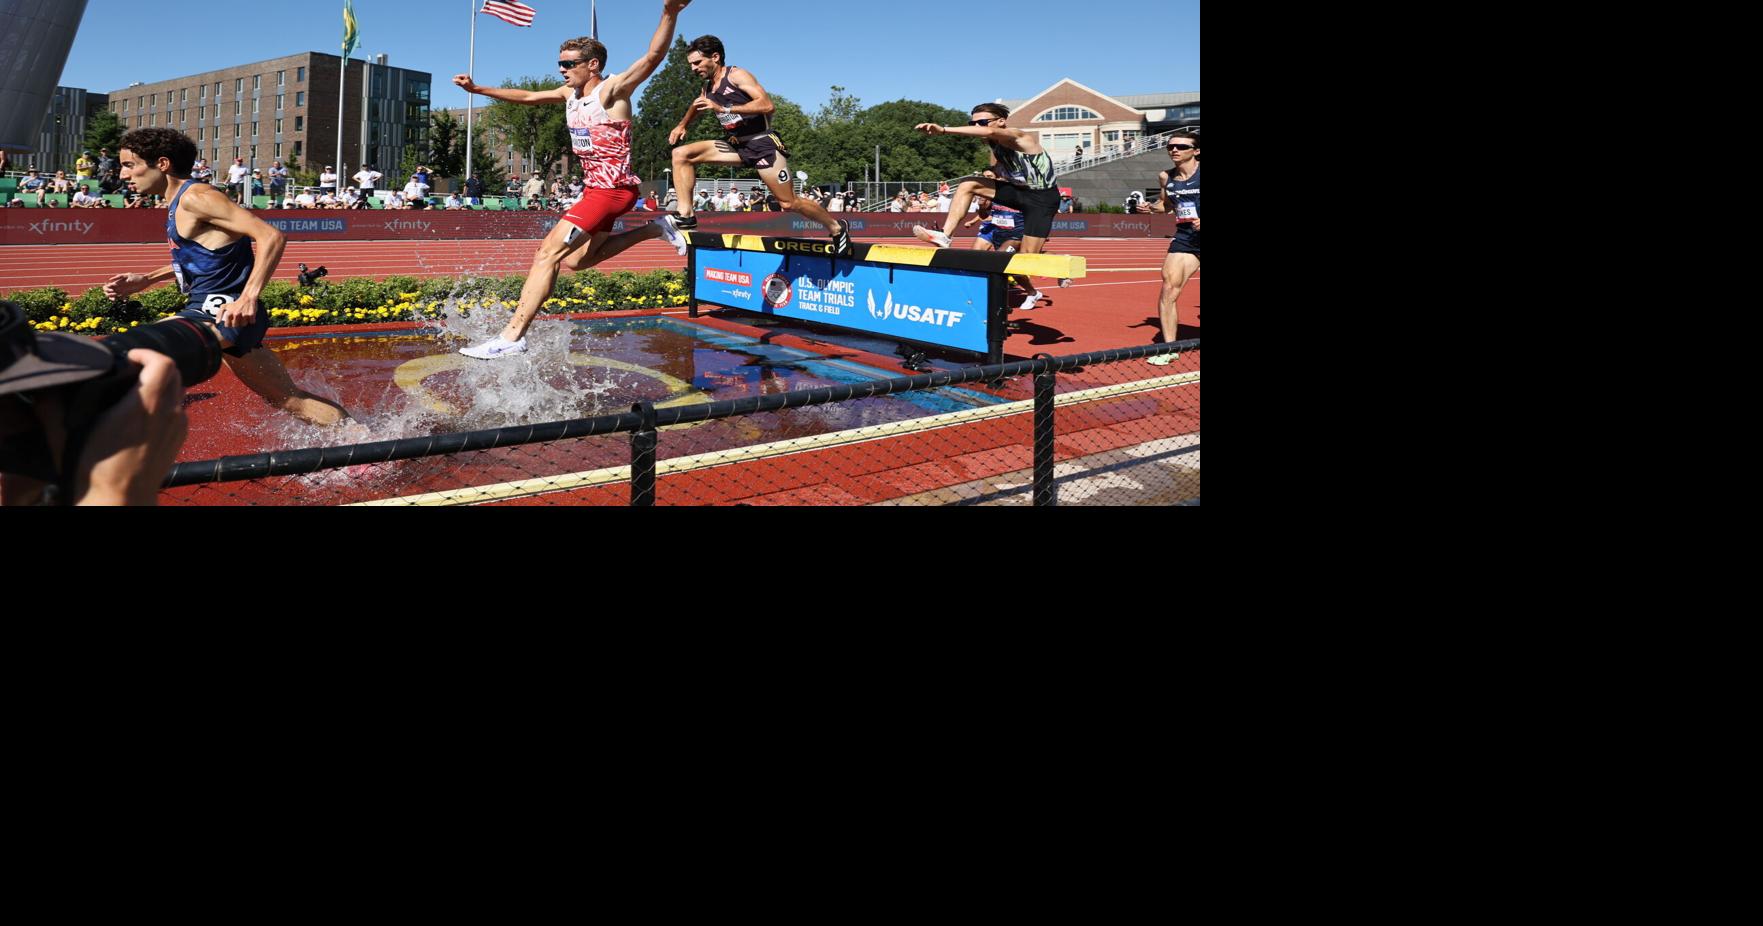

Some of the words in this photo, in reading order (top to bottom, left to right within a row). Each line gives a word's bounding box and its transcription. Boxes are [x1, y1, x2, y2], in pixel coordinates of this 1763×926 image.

[778, 169, 788, 182] 9
[28, 218, 94, 235] xfinity
[289, 220, 318, 231] TEAM
[320, 220, 343, 231] USA
[383, 218, 431, 232] xfinity
[1070, 221, 1085, 230] USA
[1112, 220, 1150, 232] xfinity
[774, 240, 852, 256] OREGO
[725, 272, 738, 283] TEAM
[738, 275, 750, 285] USA
[798, 277, 815, 289] U.S.
[817, 278, 855, 294] OLYMPIC
[798, 289, 821, 302] TEAM
[823, 291, 855, 308] TRIALS
[205, 296, 227, 318] 3
[798, 301, 818, 312] TRACK
[818, 303, 824, 313] &
[823, 304, 841, 316] FIELD
[893, 303, 966, 328] USATF
